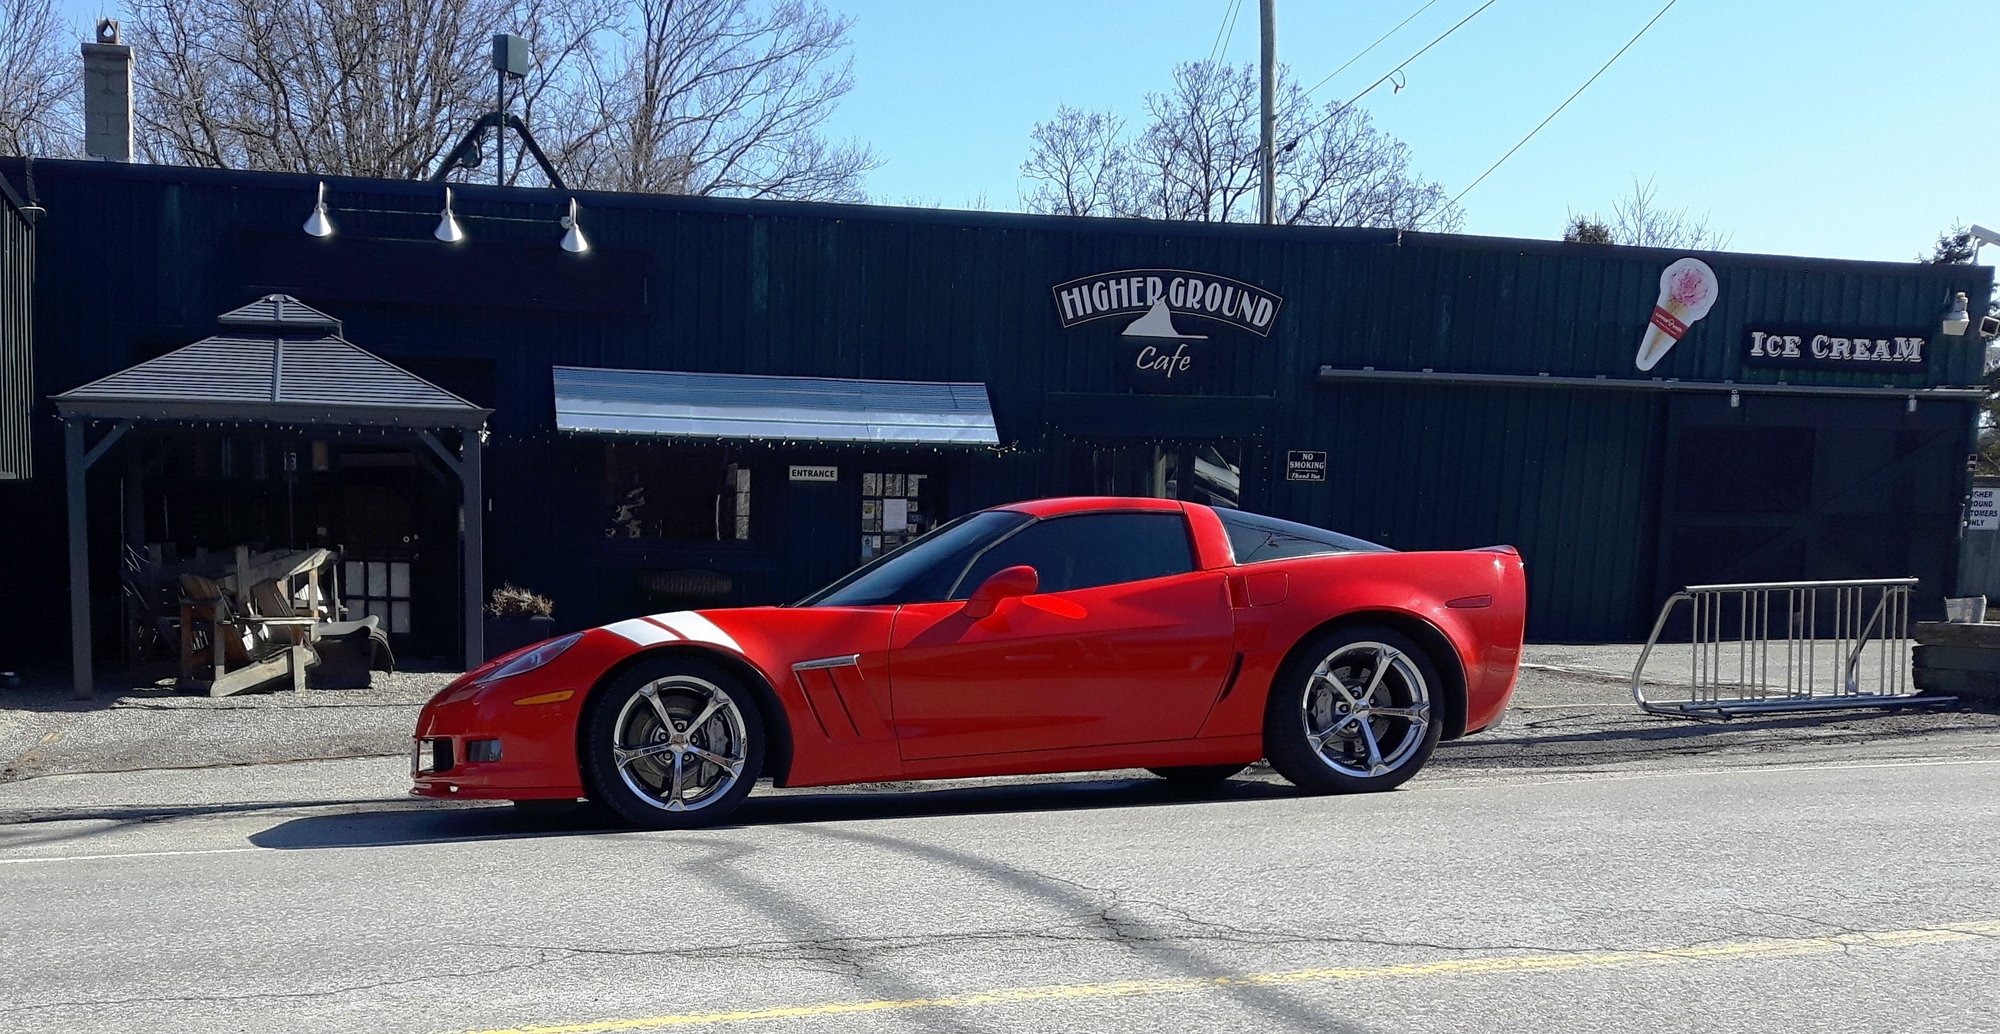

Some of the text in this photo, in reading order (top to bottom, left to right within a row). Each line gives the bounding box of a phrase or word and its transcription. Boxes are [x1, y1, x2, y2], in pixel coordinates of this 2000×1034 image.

[1060, 276, 1273, 327] HIGHER GROUND
[1136, 343, 1191, 378] Cafe
[1750, 331, 1925, 362] ICE CREAM
[791, 469, 835, 478] ENTRANCE
[1290, 461, 1324, 469] SMOKING
